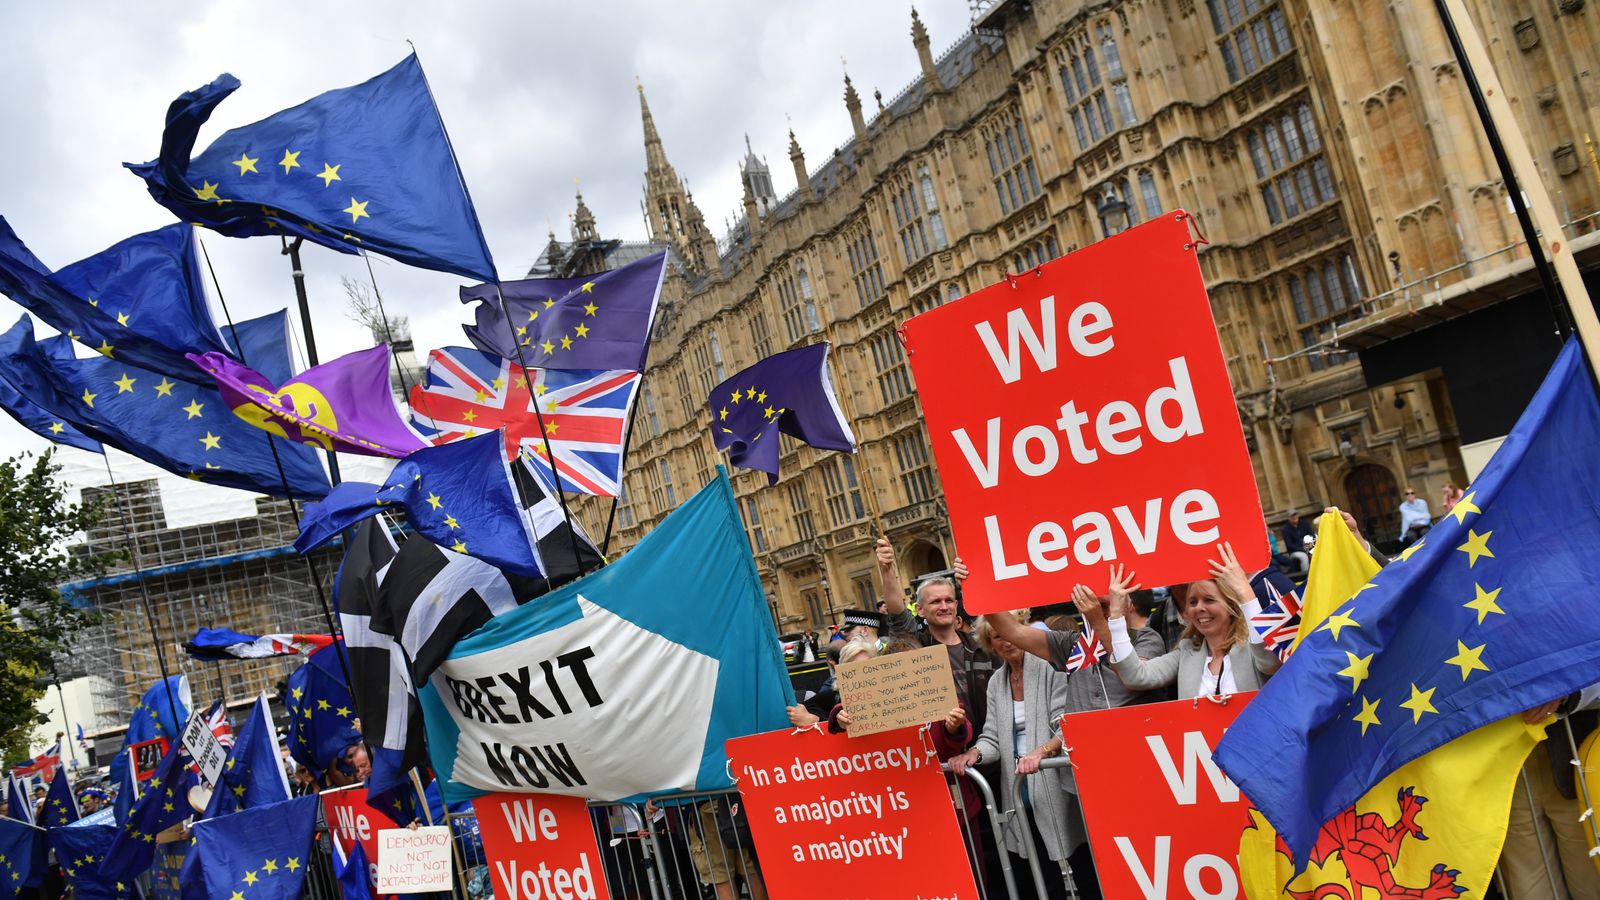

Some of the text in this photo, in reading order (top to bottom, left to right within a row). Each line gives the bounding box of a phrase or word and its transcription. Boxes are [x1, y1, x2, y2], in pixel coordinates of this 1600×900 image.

[974, 295, 1115, 385] We
[951, 355, 1204, 489] Voted
[983, 488, 1221, 582] Leave
[445, 645, 604, 724] BREXIT
[841, 654, 932, 680] NOT CONTENT WITH
[841, 664, 944, 692] FUCKING OTHER WOMEN
[844, 690, 873, 705] BORIS
[921, 676, 931, 684] TO
[845, 703, 866, 714] FUCK
[480, 741, 588, 789] NOW
[773, 766, 787, 784] a
[790, 745, 920, 782] democracy,
[334, 805, 371, 841] We
[501, 799, 559, 843] We
[774, 786, 910, 825] a majority is
[386, 833, 450, 849] DEMOCRACY
[407, 850, 433, 862] NOT
[791, 844, 806, 862] a
[389, 860, 448, 874] NOT NOT
[495, 852, 597, 900] Voted
